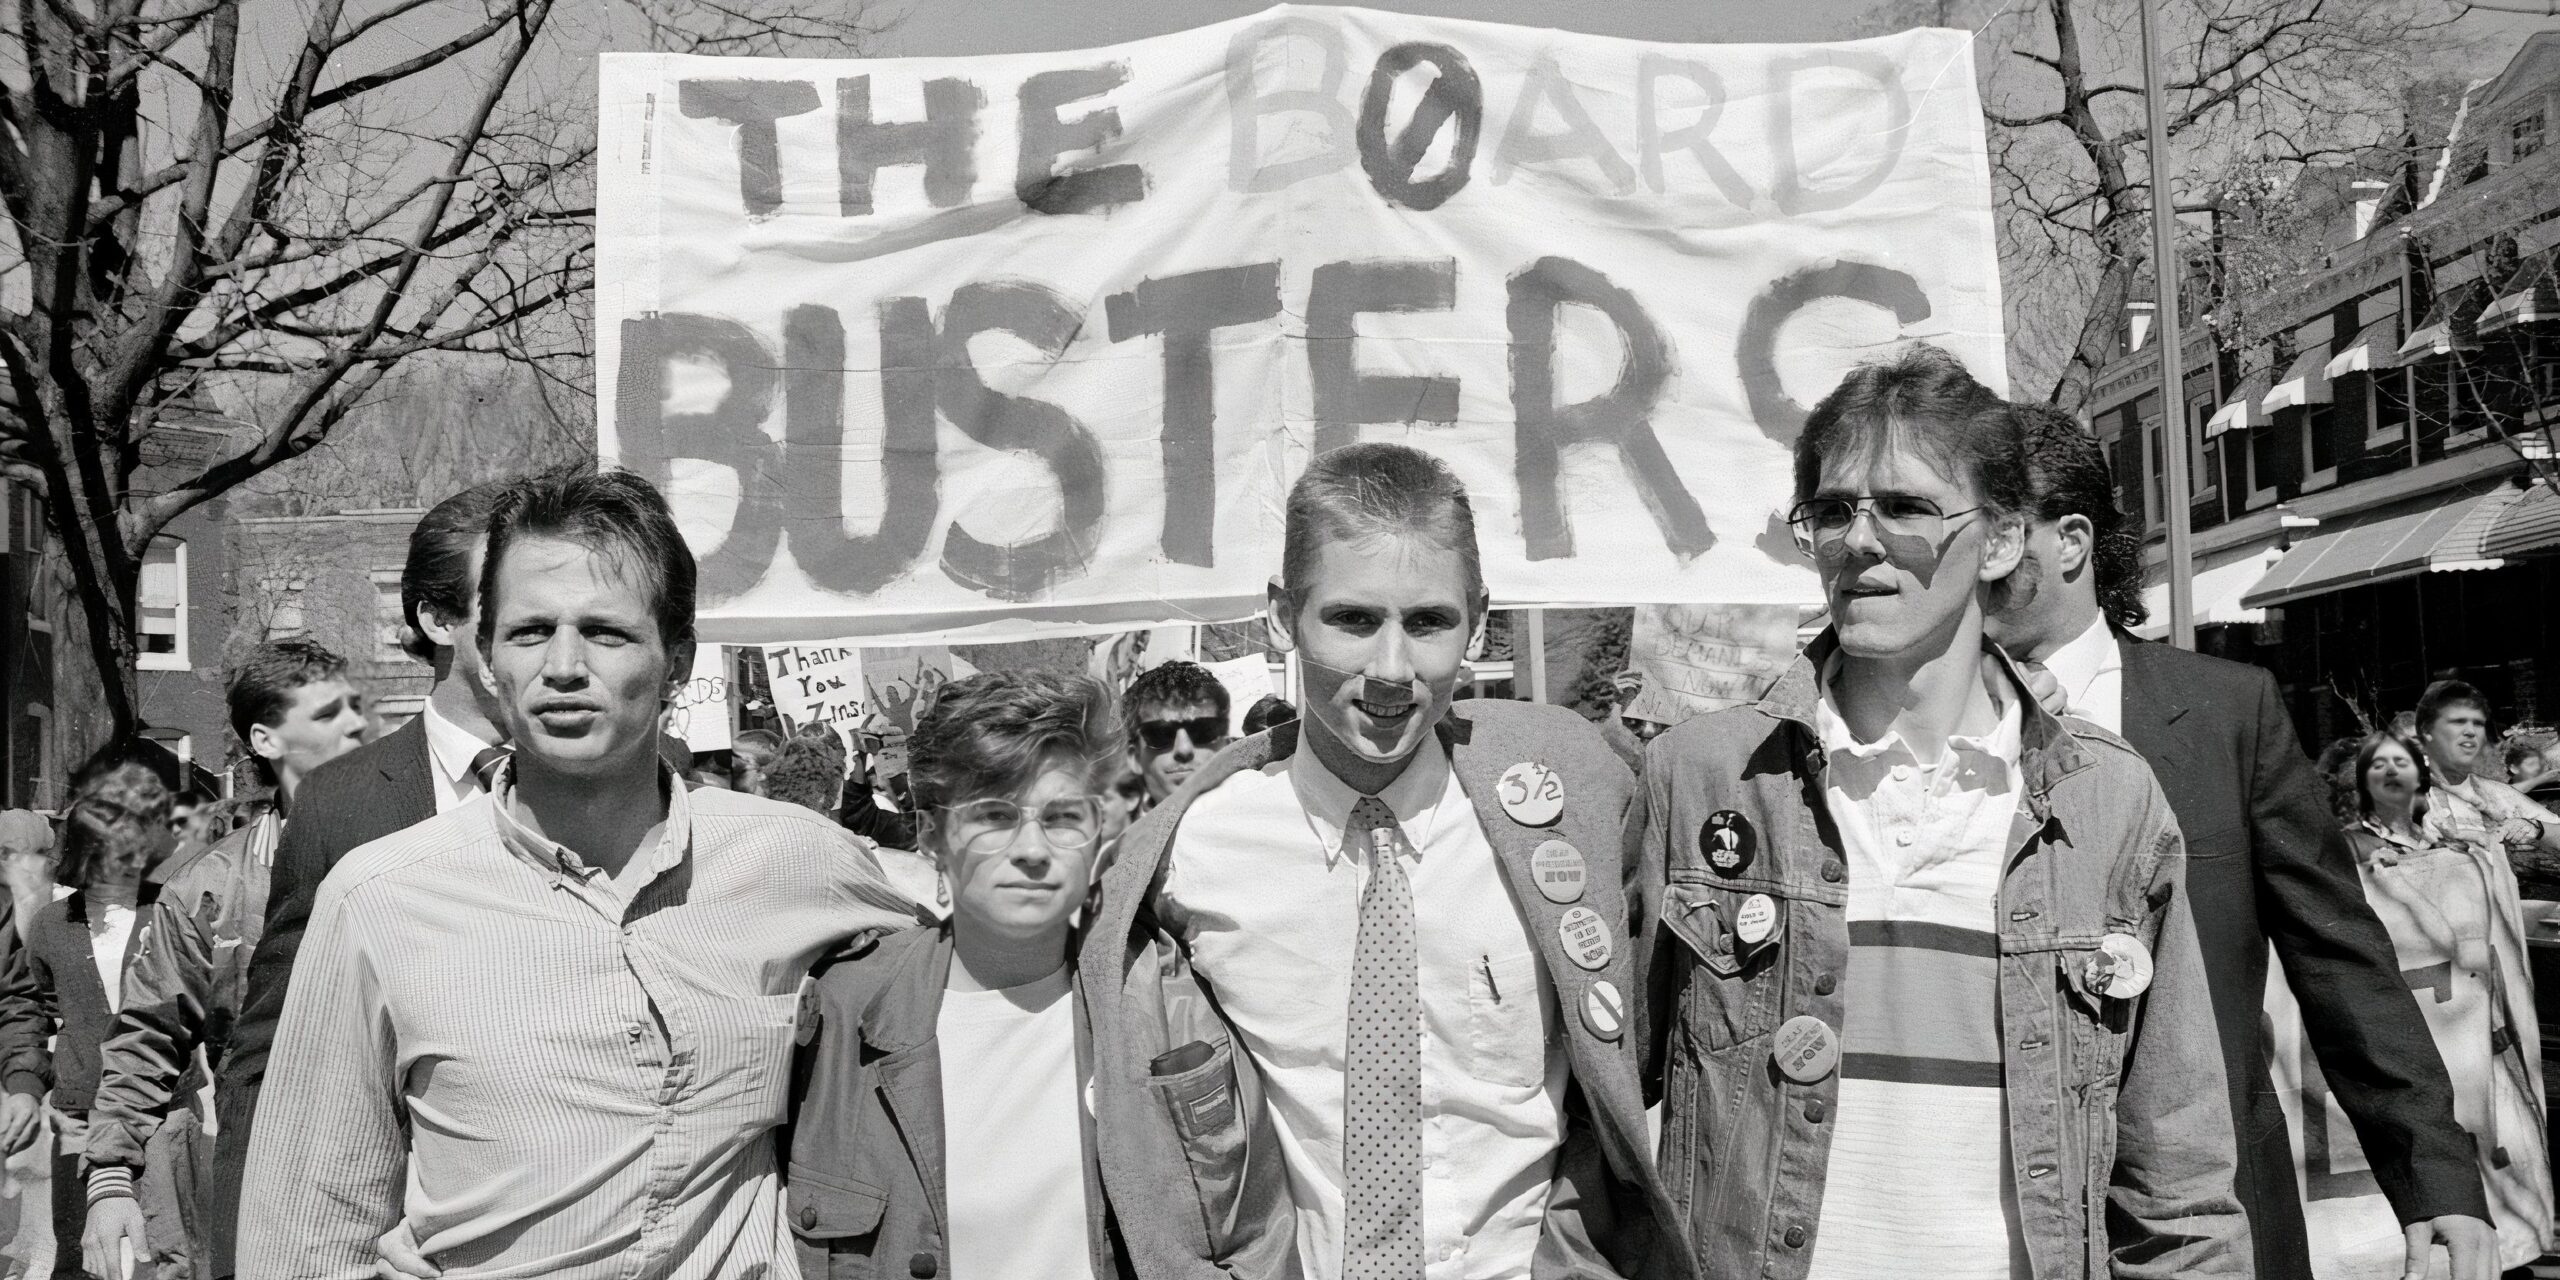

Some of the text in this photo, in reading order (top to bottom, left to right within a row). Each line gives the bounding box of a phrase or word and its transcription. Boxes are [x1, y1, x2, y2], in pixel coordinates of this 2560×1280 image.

[678, 58, 1151, 220] THE
[615, 256, 1931, 602] BUSTERS
[768, 647, 852, 678] Thank
